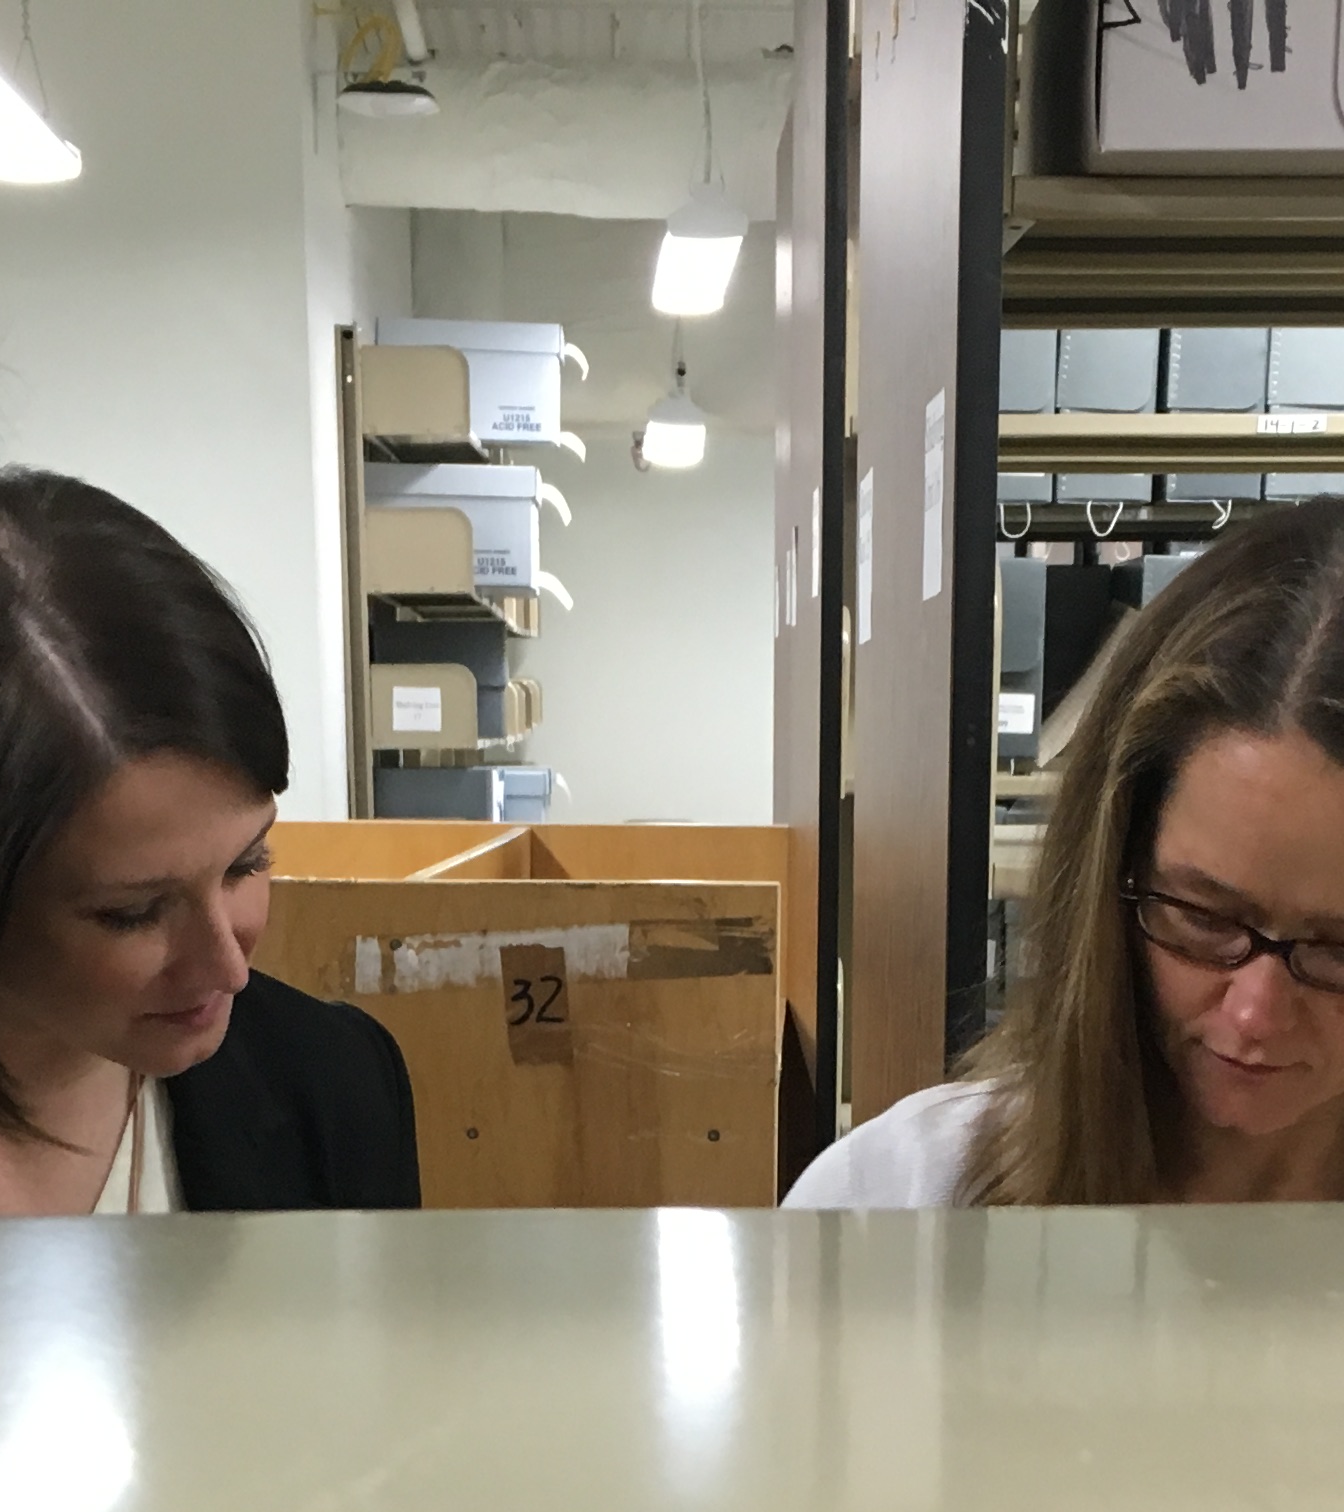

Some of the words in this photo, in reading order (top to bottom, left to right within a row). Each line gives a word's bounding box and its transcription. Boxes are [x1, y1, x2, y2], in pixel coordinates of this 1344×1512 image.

[491, 422, 514, 431] ACID
[516, 422, 542, 432] FREE
[491, 566, 517, 576] FREE
[508, 975, 566, 1026] 32
